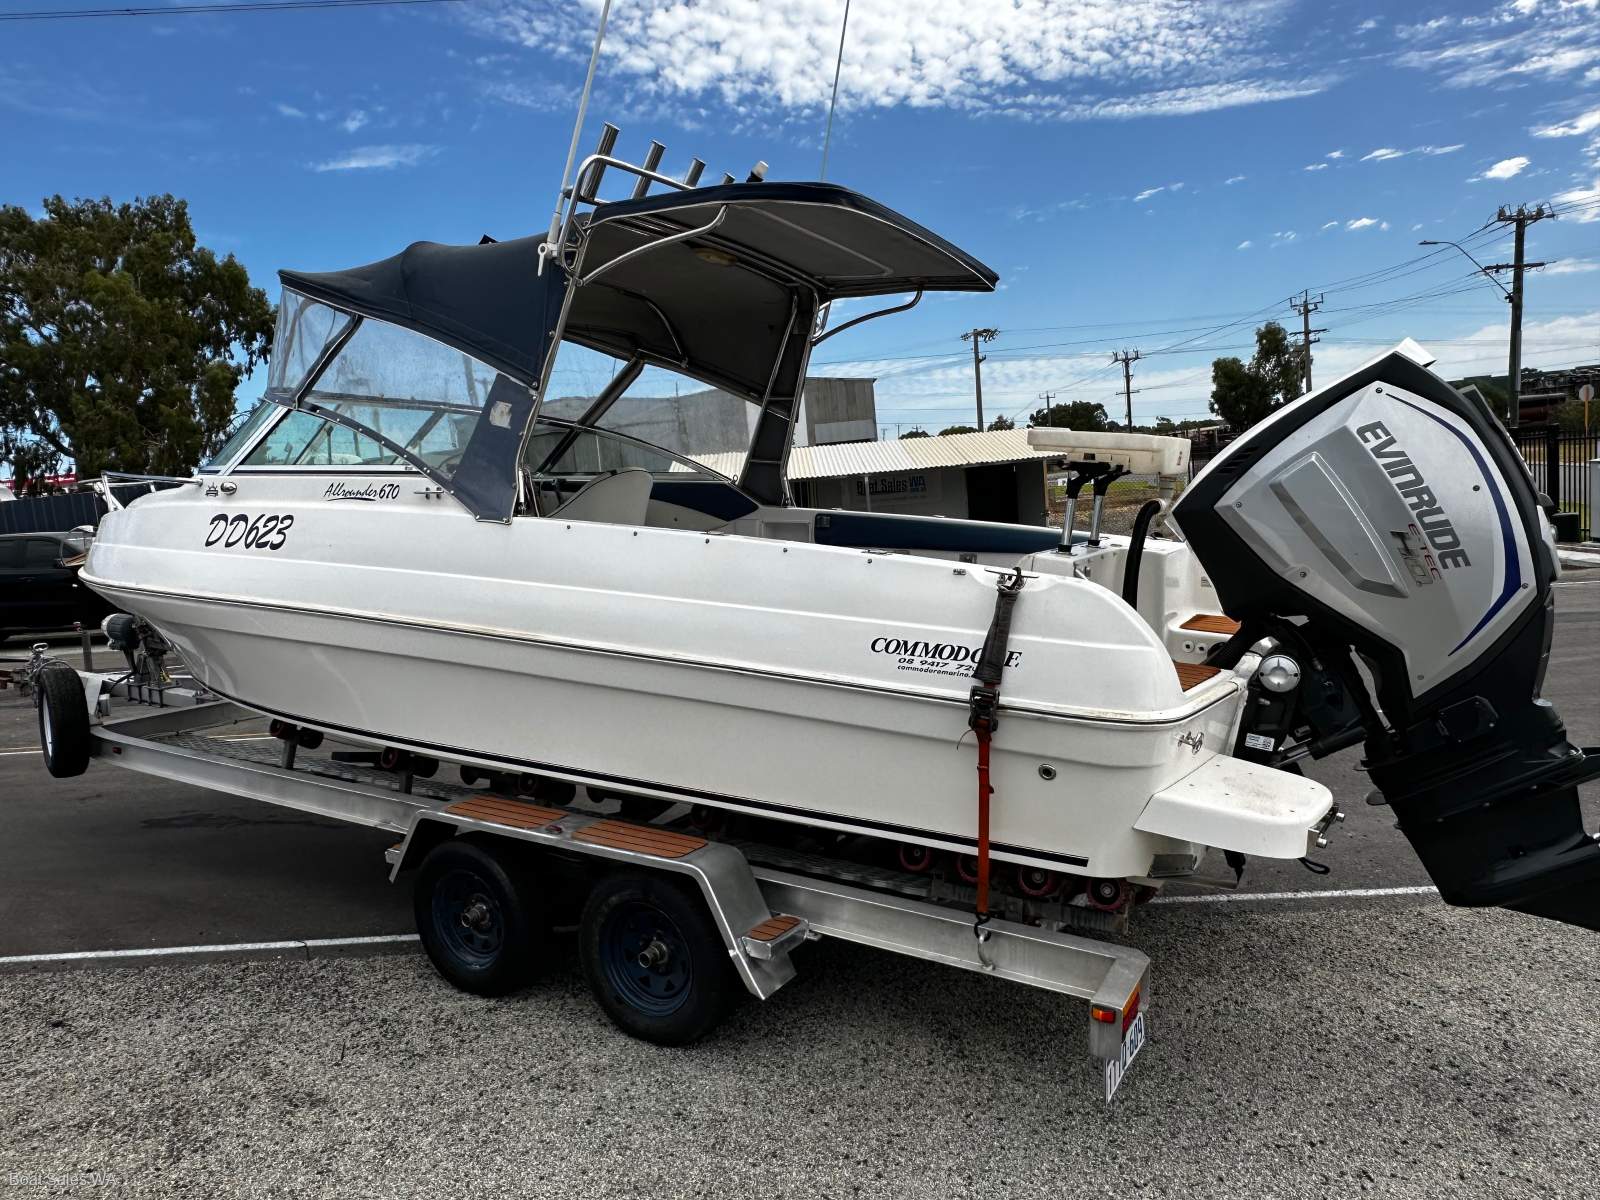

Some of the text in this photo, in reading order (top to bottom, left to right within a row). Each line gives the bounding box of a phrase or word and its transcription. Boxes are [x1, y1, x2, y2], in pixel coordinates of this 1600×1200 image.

[324, 482, 400, 500] Allrounder 670
[881, 476, 907, 494] Sales
[1356, 420, 1471, 569] EVINRUDE
[205, 513, 294, 550] DD623
[1408, 523, 1442, 580] E-TEC
[870, 637, 1022, 668] COMMODOE
[898, 657, 914, 665] 08
[920, 659, 950, 668] 9417
